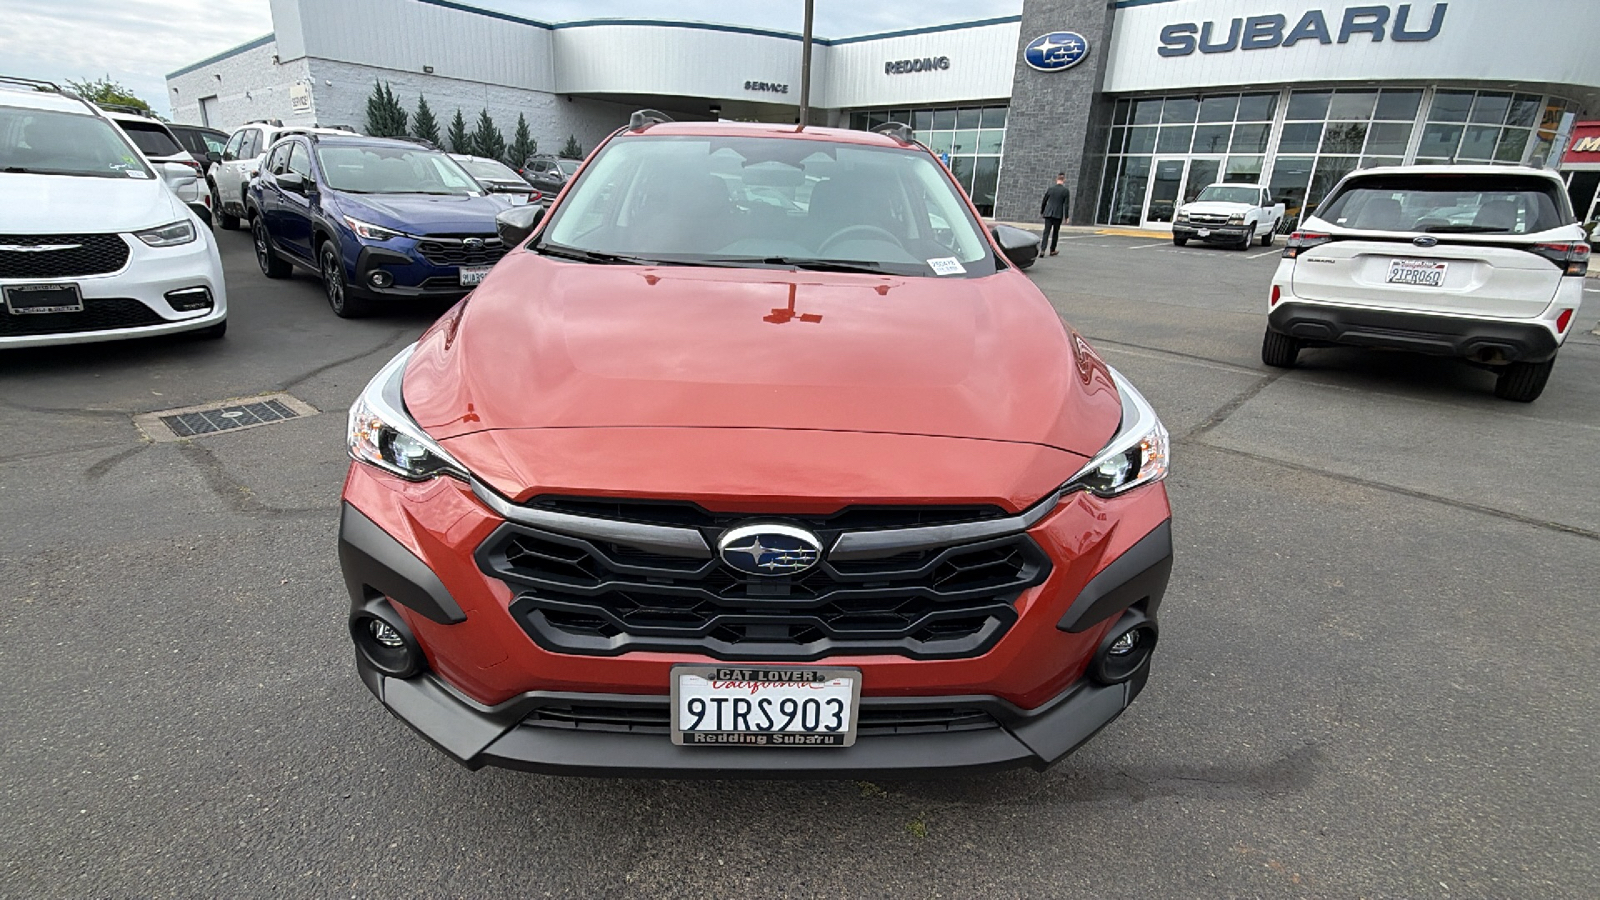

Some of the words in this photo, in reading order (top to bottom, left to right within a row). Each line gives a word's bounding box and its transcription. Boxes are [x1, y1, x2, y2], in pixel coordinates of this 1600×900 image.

[1157, 3, 1448, 57] SUBARU
[884, 56, 951, 75] REDDING
[744, 80, 789, 94] SERVICE
[719, 669, 751, 681] CAT
[758, 671, 815, 682] LOVER
[686, 697, 845, 732] 9TRS903
[694, 734, 768, 745] Redding
[772, 733, 835, 744] Subaru
